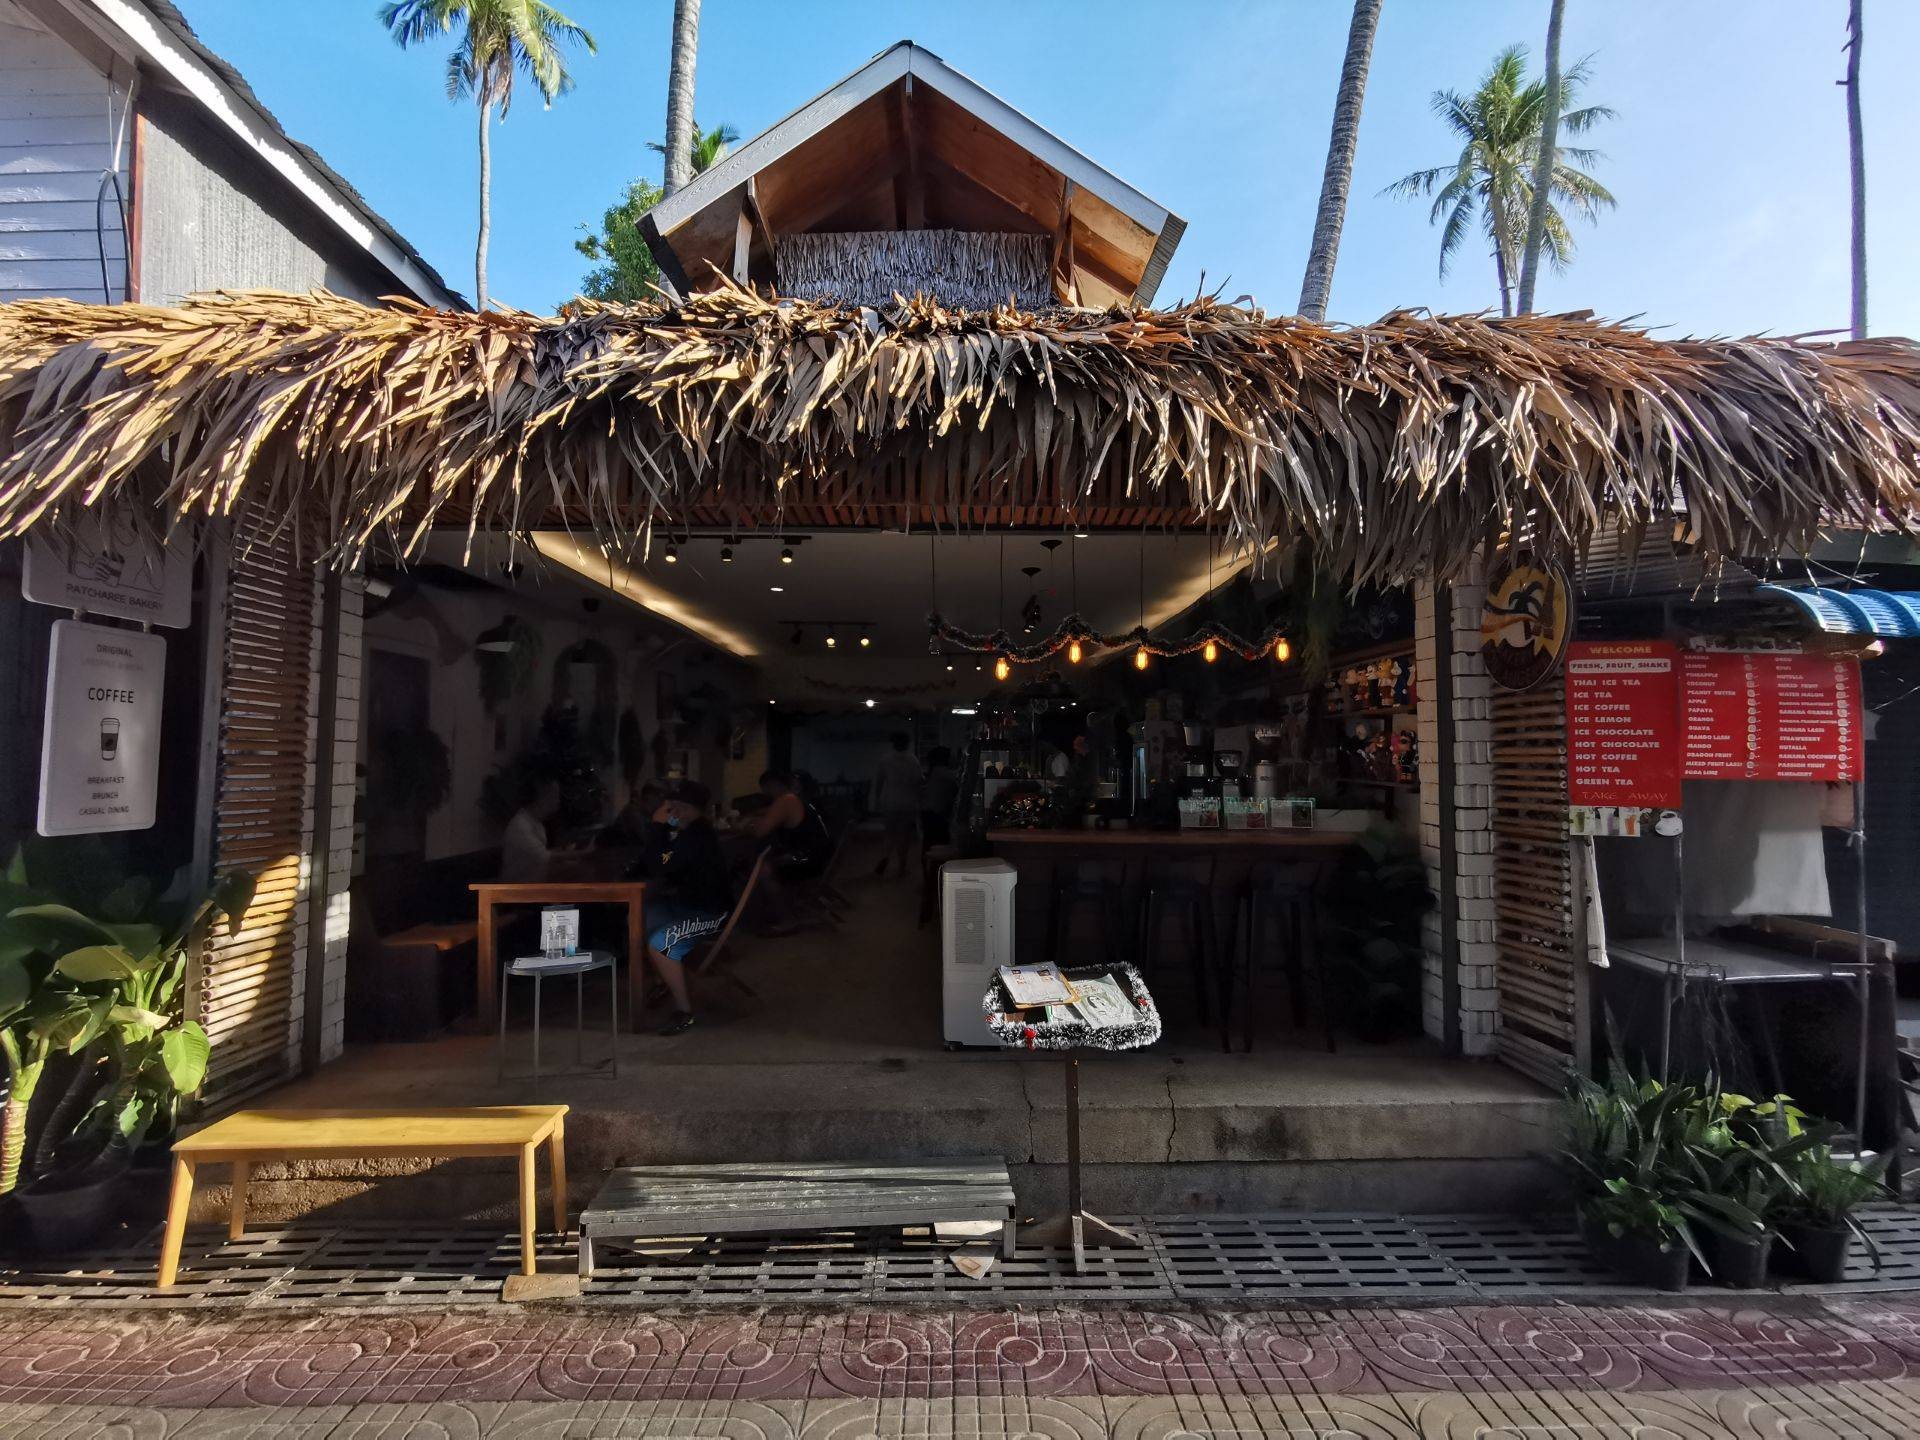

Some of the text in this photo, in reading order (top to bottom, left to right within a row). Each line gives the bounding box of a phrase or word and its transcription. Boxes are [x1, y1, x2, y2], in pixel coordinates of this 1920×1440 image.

[66, 583, 163, 611] PATCHAREE BAKERY
[96, 644, 134, 658] ORIGINAL
[1590, 646, 1653, 654] WELCOME
[1572, 662, 1604, 670] FRESH,
[1606, 662, 1636, 670] FRUIT,
[88, 687, 135, 704] COFFEE
[1595, 716, 1632, 724] LEMON
[1602, 741, 1660, 749] CHOCOLATE
[1576, 753, 1638, 761] HOT COFFEE
[87, 776, 125, 784] BREAKFAST
[91, 792, 119, 800] BRUNCH
[1582, 791, 1668, 802] TAKE AWAY
[79, 806, 130, 816] CASUAL DINING
[662, 914, 728, 950] Billabong
